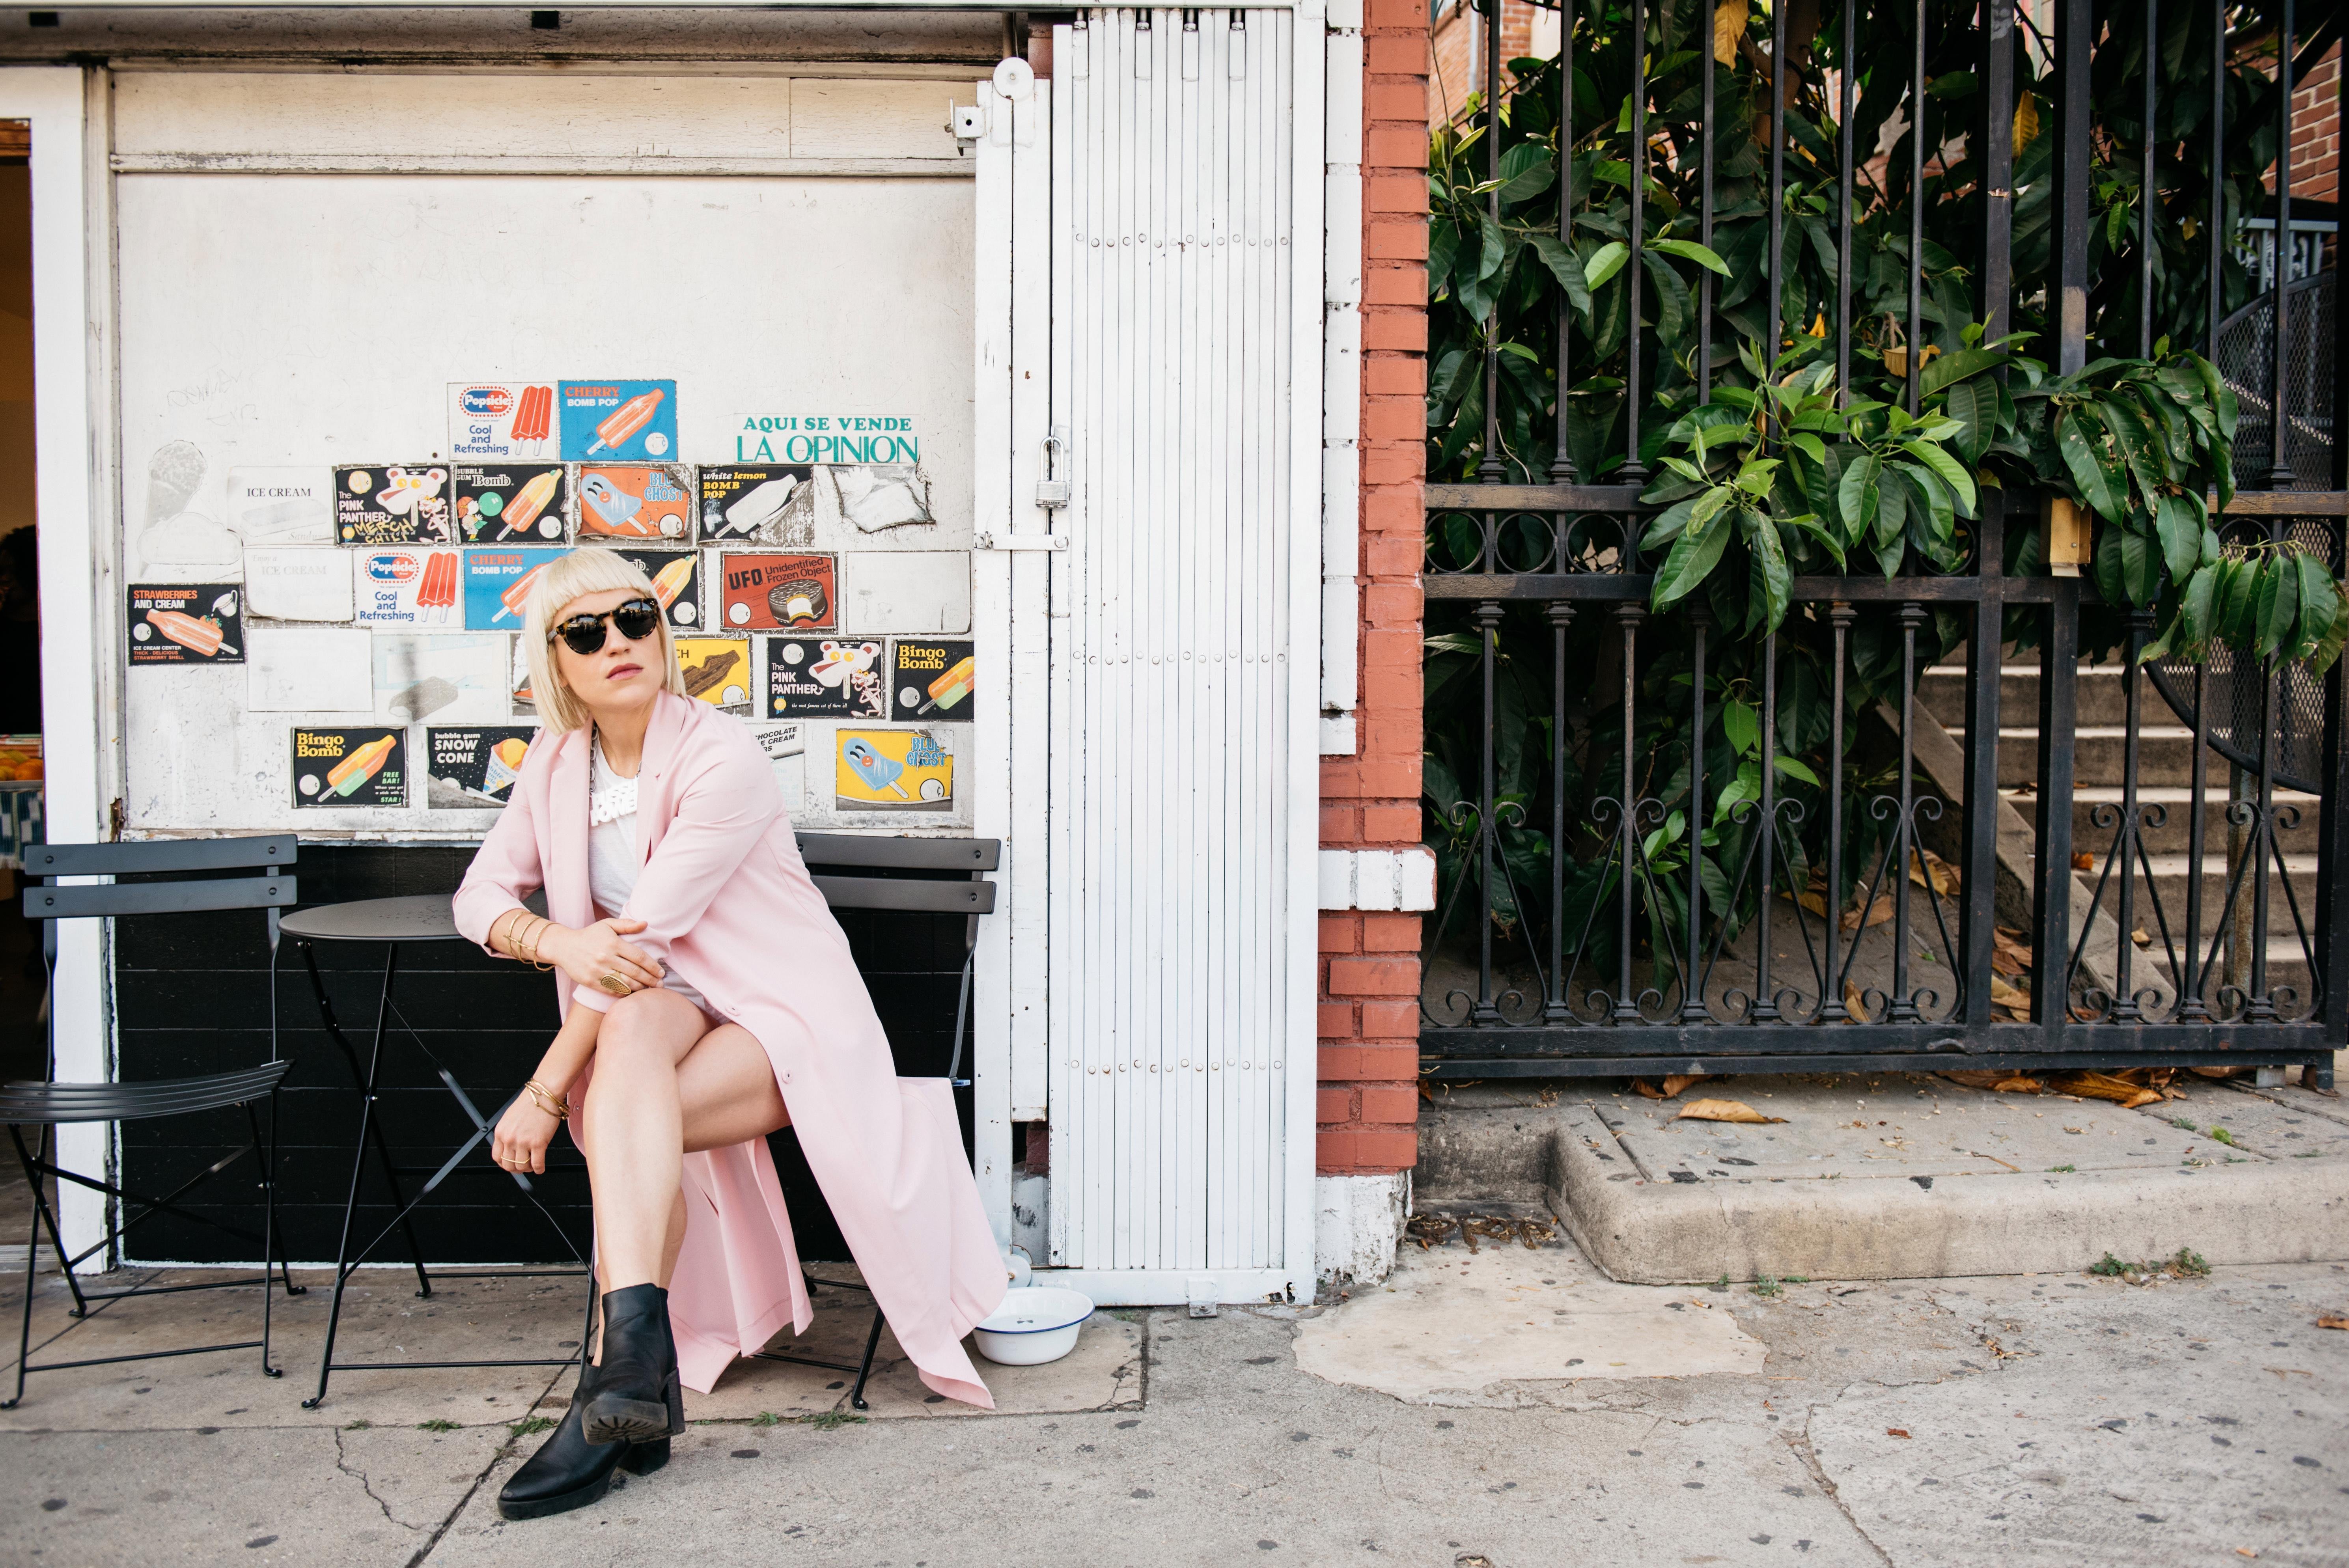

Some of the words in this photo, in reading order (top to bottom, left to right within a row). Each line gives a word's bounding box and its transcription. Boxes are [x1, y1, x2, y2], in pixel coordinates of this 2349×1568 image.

[565, 386, 620, 397] CHERRY
[464, 394, 510, 408] Popsicle
[469, 425, 491, 434] Cool
[743, 417, 797, 433] AQUI
[804, 417, 830, 431] SE
[838, 418, 912, 431] VENDE
[471, 434, 490, 443] and
[454, 444, 509, 455] Refreshing
[737, 435, 776, 462] LA
[786, 435, 918, 463] OPINION
[471, 474, 511, 487] Bomb
[649, 472, 675, 487] BLU
[703, 481, 740, 490] BOMB
[247, 488, 265, 497] ICE
[269, 488, 311, 497] CREAM
[644, 486, 683, 502] GHOST
[703, 490, 726, 499] POP
[339, 500, 364, 511] PINK
[340, 512, 393, 523] PANTHER
[470, 554, 524, 565] CHERRY
[261, 566, 280, 575] ICE
[284, 565, 327, 575] CREAM
[370, 560, 415, 574] Popsicle
[765, 557, 824, 575] Unidentified
[728, 569, 763, 590] UFO
[767, 572, 799, 584] Frozen
[800, 564, 831, 577] Object
[133, 590, 198, 599] STRAWBERRIES
[375, 591, 397, 600] Cool
[134, 600, 152, 609] AND
[155, 600, 185, 609] CREAM
[377, 601, 396, 610] and
[360, 611, 414, 622] Refreshing
[898, 645, 946, 661] Bingo
[898, 657, 944, 669] Bomb
[771, 672, 796, 682] PINK
[771, 684, 825, 695] PANTHER
[297, 733, 345, 748] Bingo
[768, 733, 795, 745] CREAM
[434, 739, 478, 751] SNOW
[297, 745, 343, 757] Bomb
[437, 752, 475, 763] CONE
[906, 750, 946, 767] GHOST
